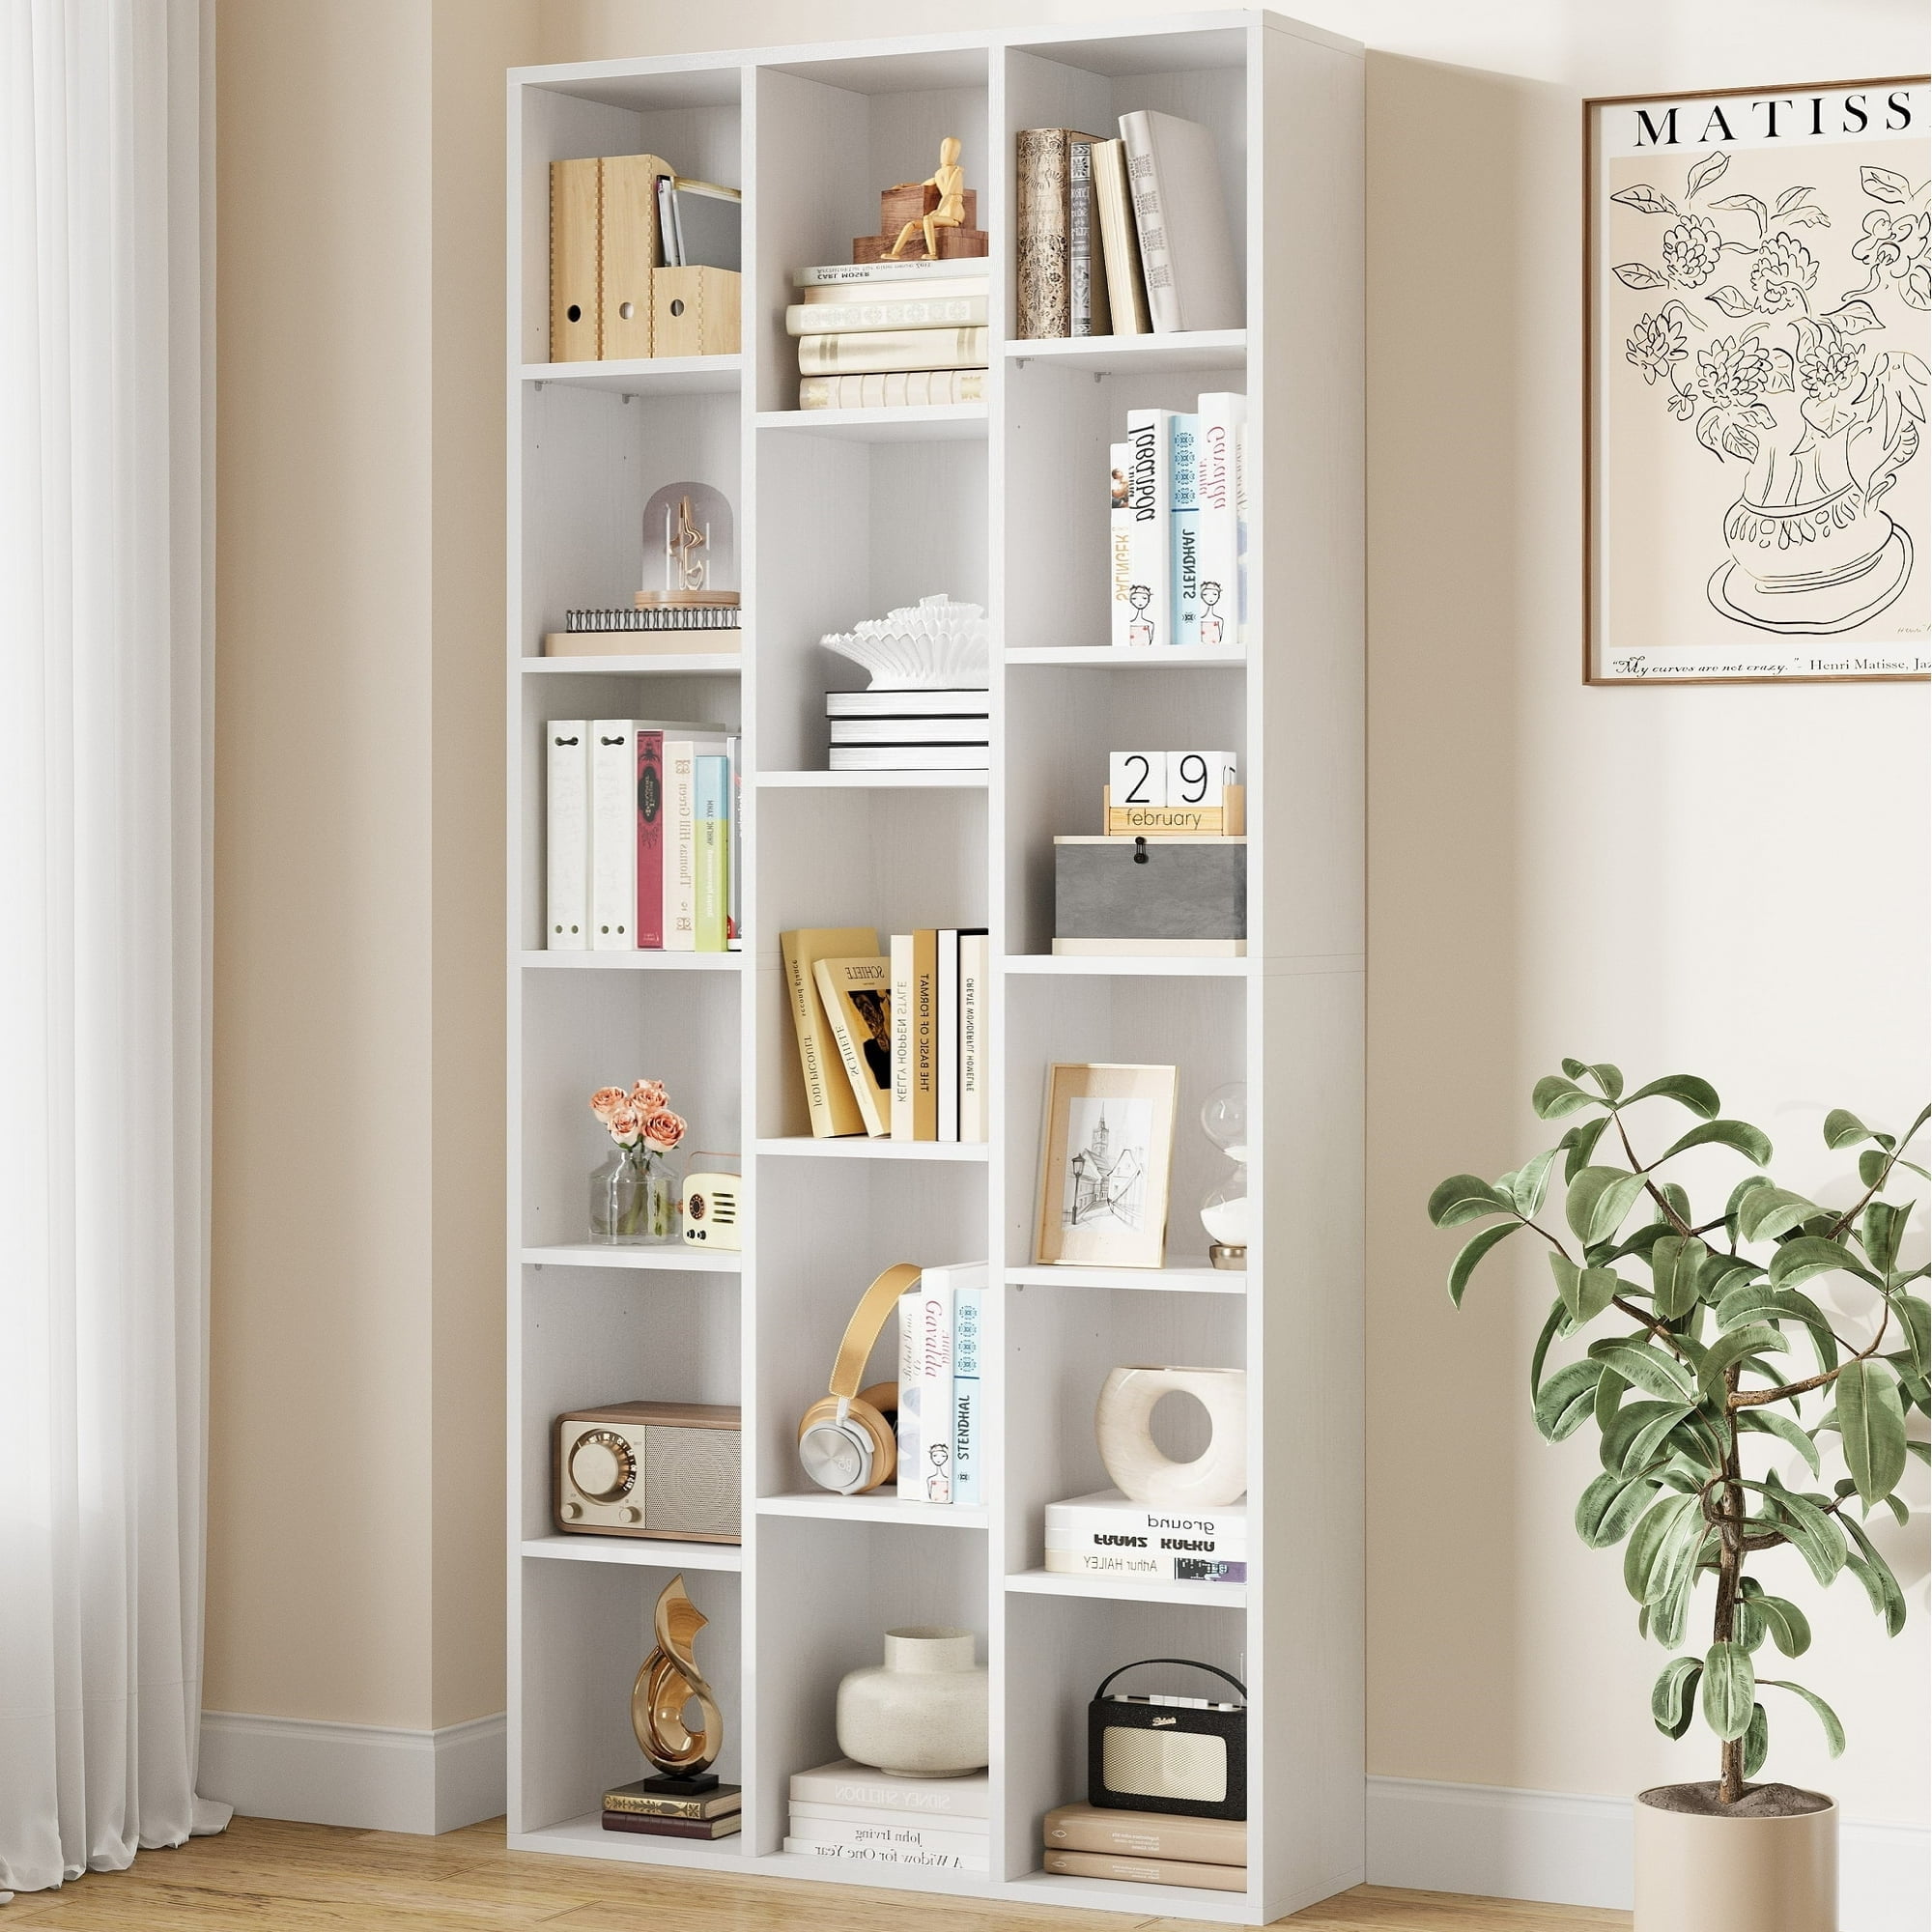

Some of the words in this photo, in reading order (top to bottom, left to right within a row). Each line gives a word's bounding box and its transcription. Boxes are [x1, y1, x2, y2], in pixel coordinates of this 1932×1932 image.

[1633, 91, 1931, 147] MATISS
[1809, 659, 1850, 670] Henri
[1855, 658, 1909, 670] Matisse,
[1125, 808, 1202, 831] february
[924, 1299, 943, 1378] Gavalda
[957, 1395, 971, 1460] STENDHAL
